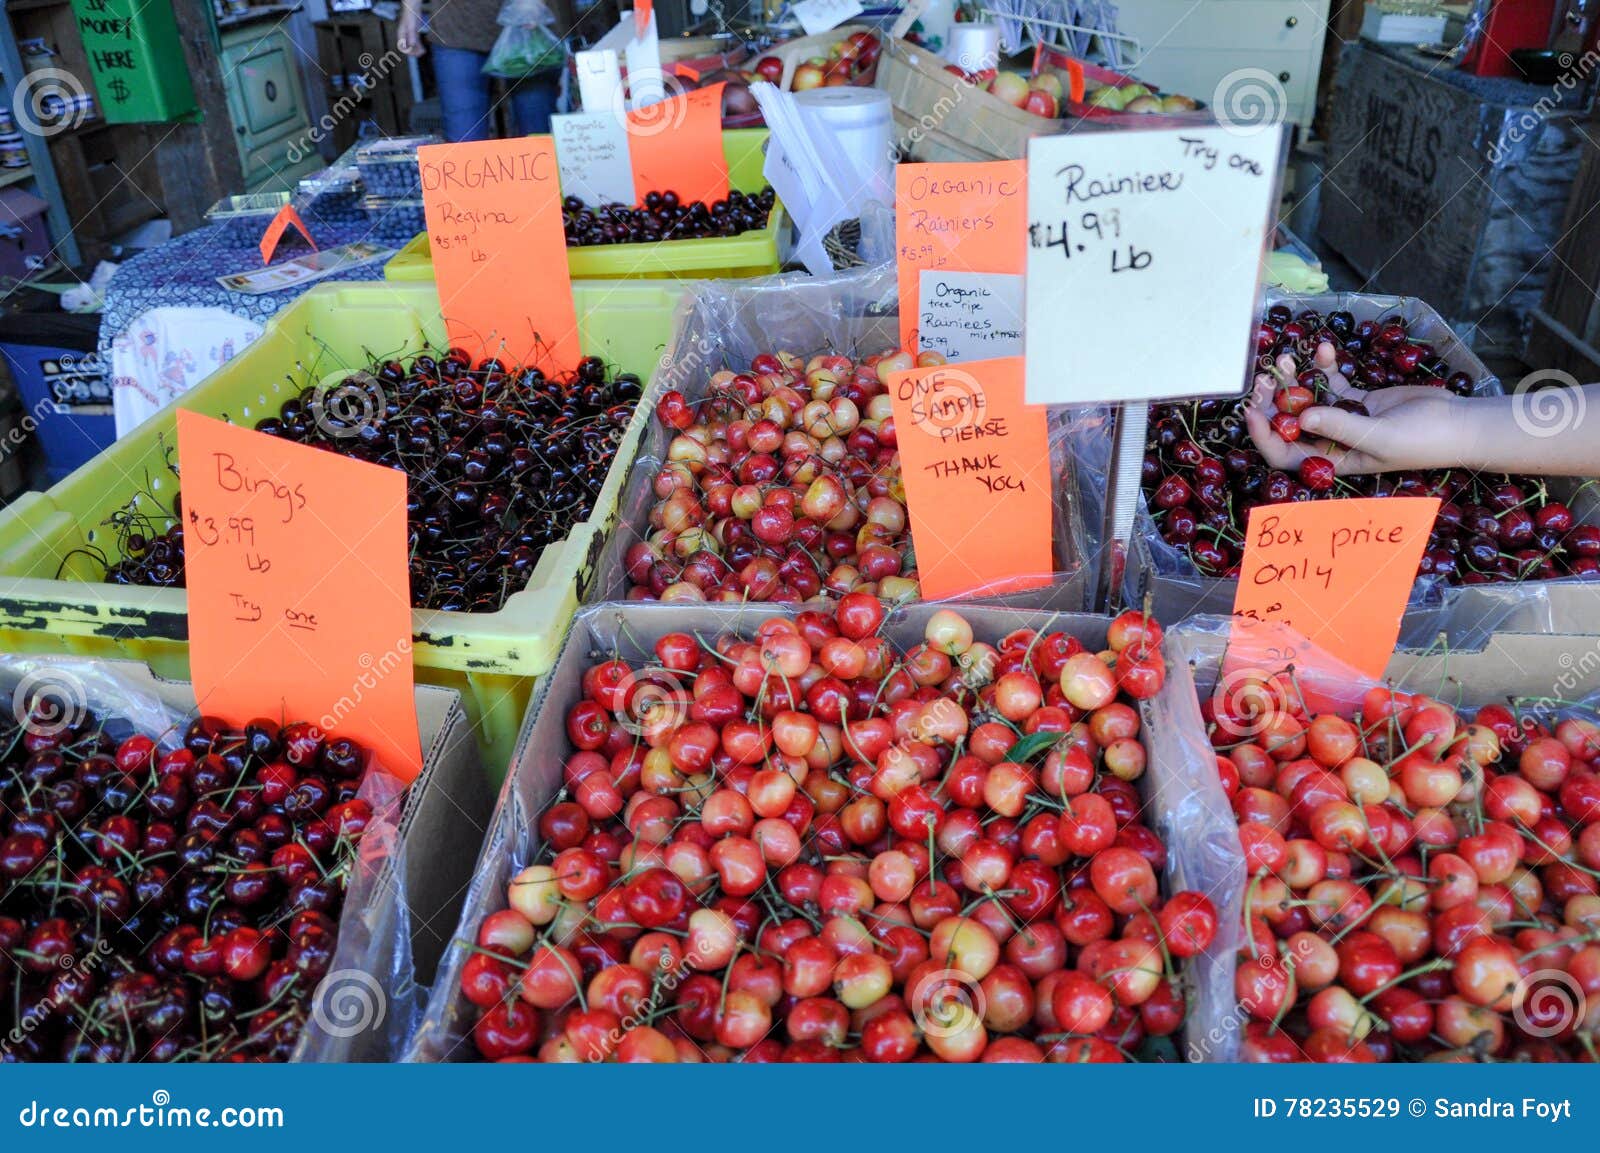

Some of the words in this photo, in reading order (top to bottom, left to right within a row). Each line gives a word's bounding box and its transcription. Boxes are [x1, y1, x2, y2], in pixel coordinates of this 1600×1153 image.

[91, 49, 136, 73] HERE
[422, 151, 549, 191] ORGANIC
[1178, 136, 1219, 171] Try
[1228, 153, 1264, 177] one
[1055, 164, 1184, 205] Rainier
[436, 201, 519, 234] Regina
[1028, 207, 1122, 259] $4.99
[435, 234, 469, 250] $5.99
[927, 299, 953, 309] tree
[961, 300, 984, 315] ripe
[935, 282, 992, 304] Organic
[898, 372, 946, 401] ONE
[924, 453, 1002, 478] THANK
[212, 452, 307, 524] Bings
[976, 475, 1026, 493] YOU
[188, 506, 255, 547] $3.99
[1257, 516, 1304, 548] Box
[1331, 519, 1404, 559] price
[229, 592, 262, 622] Try
[284, 608, 318, 625] one
